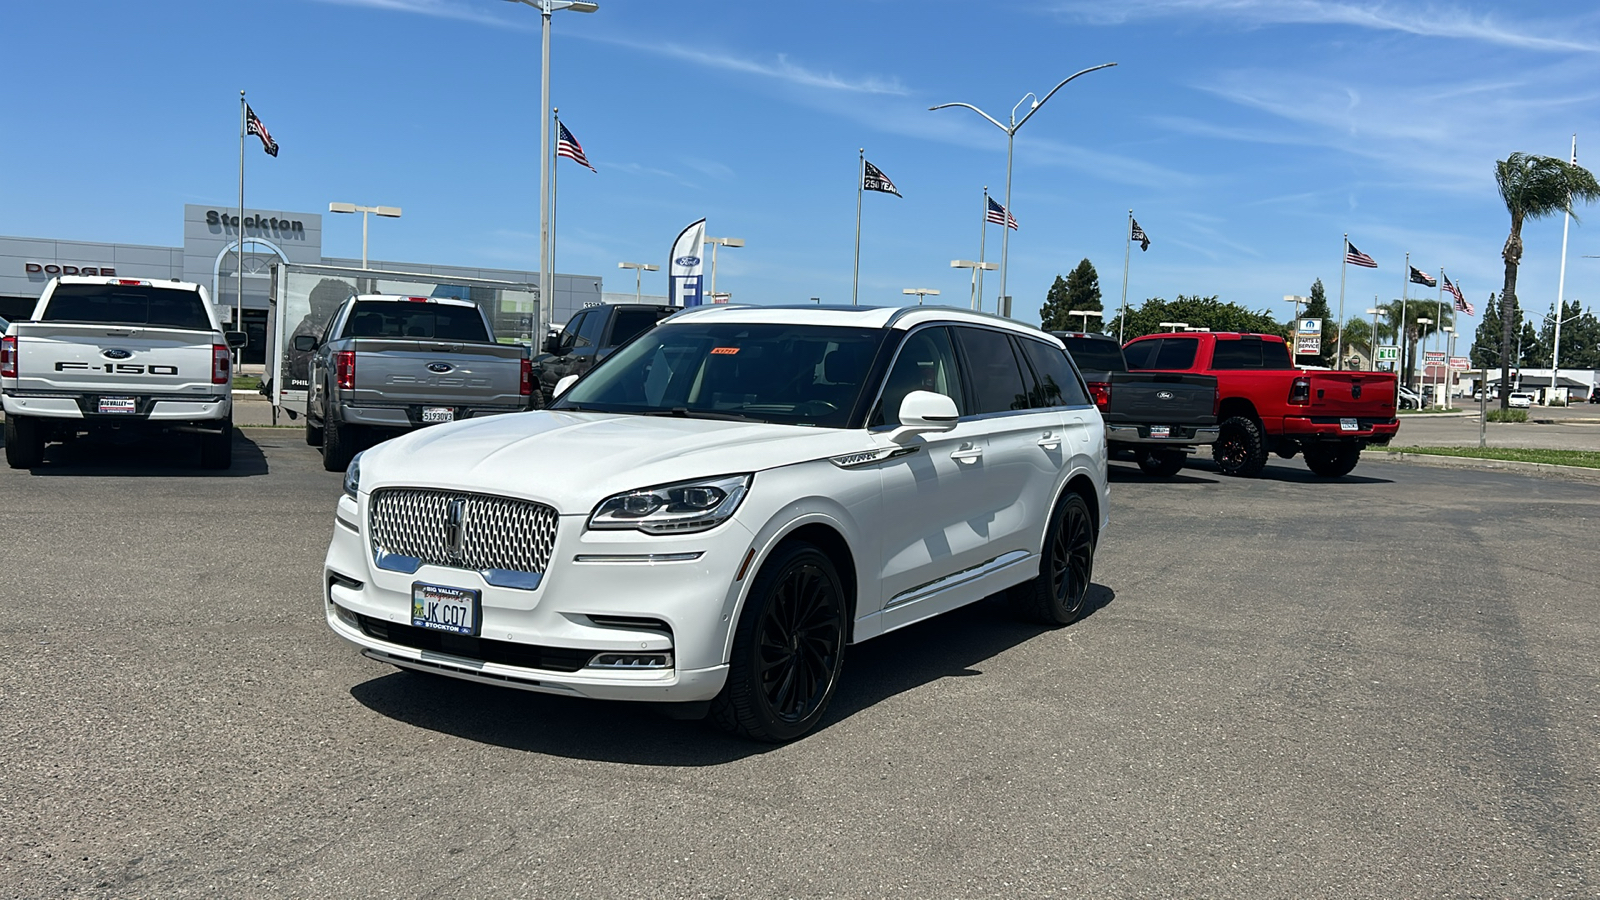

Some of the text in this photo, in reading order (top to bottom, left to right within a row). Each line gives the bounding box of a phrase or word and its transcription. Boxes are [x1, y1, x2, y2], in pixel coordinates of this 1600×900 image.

[865, 180, 880, 188] 250
[205, 210, 304, 231] Stockton
[680, 257, 698, 266] Ford
[25, 263, 116, 277] DODGE
[54, 361, 179, 376] F-150
[438, 588, 459, 596] VALLEY
[424, 601, 439, 622] JK
[425, 621, 459, 632] STOCKTON
